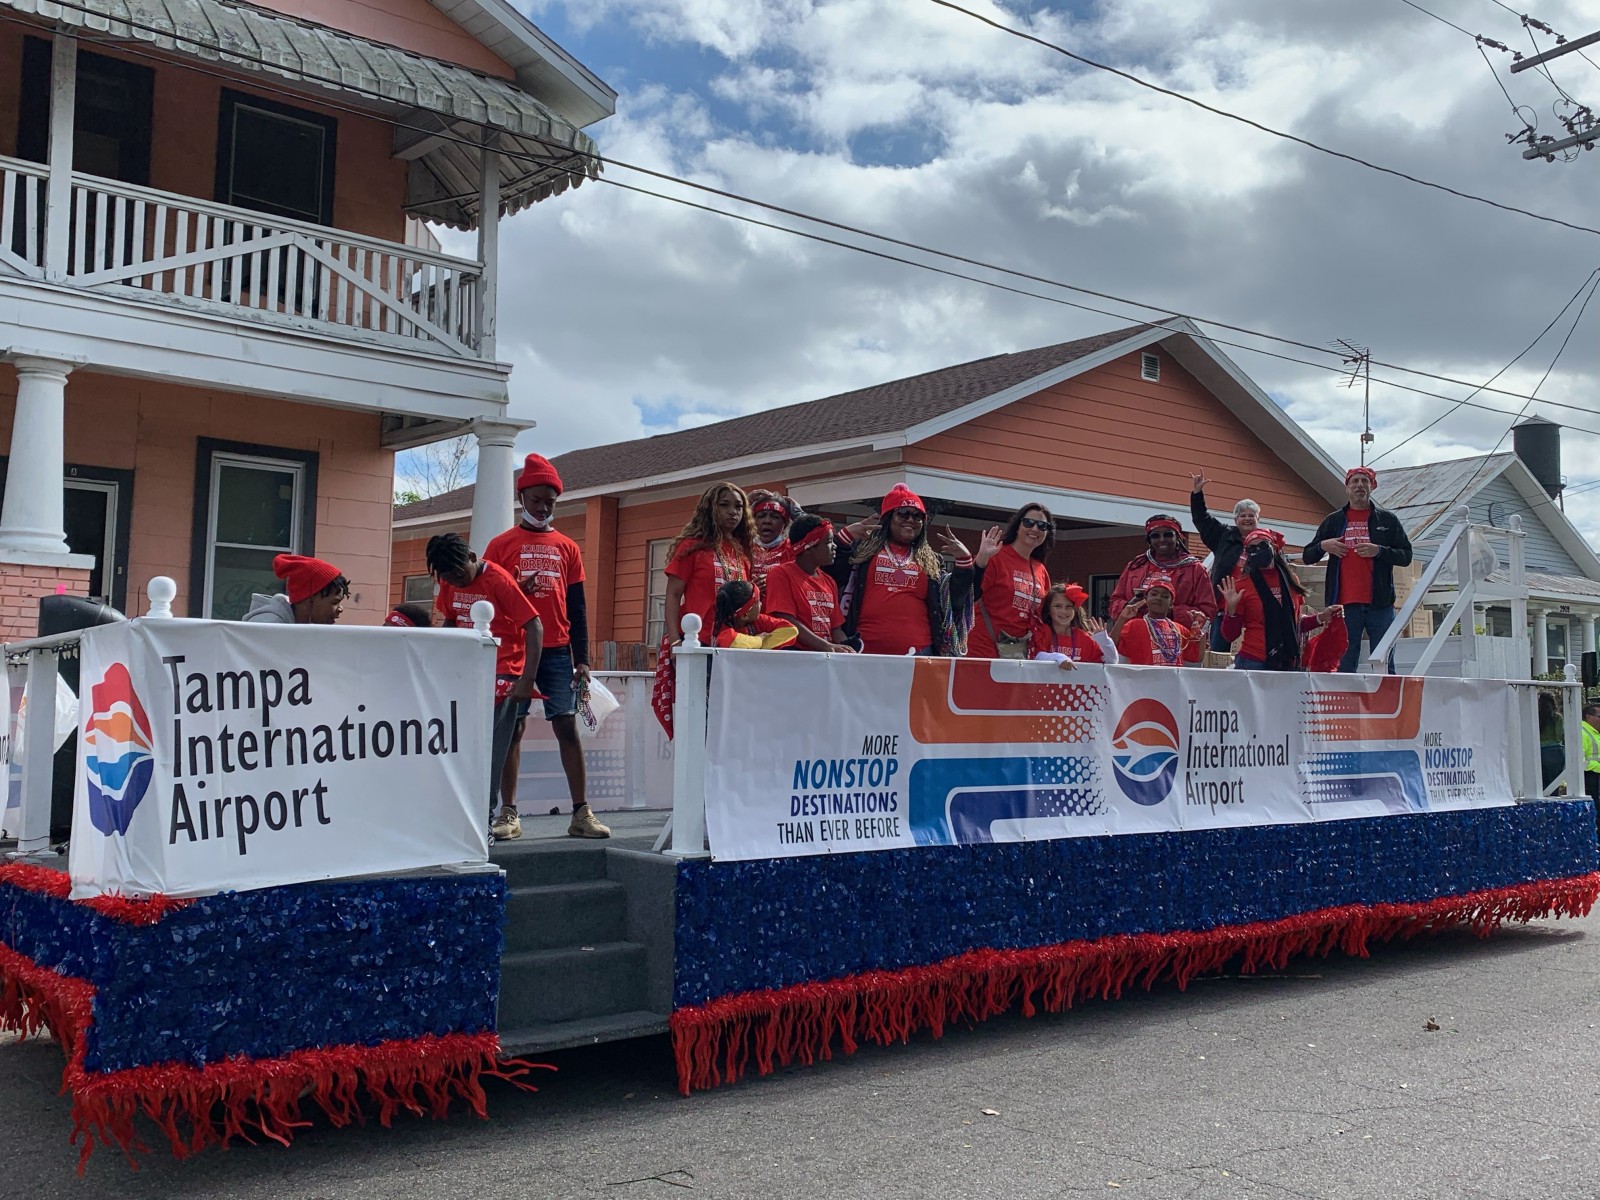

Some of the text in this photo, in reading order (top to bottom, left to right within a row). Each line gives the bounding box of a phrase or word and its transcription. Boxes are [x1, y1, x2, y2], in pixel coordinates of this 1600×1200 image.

[520, 559, 560, 572] DREAM
[162, 655, 313, 727] Tampa
[1188, 699, 1239, 744] Tampa
[173, 700, 459, 777] International
[861, 735, 899, 755] MORE
[1186, 733, 1289, 768] International
[1424, 732, 1442, 747] MORE
[1425, 748, 1473, 769] NONSTOP
[792, 758, 899, 790] NONSTOP
[1426, 770, 1476, 787] DESTINATIONS
[790, 791, 898, 817] DESTINATIONS
[1185, 771, 1245, 816] Airport
[1430, 789, 1446, 804] THAN
[169, 778, 331, 855] Airport
[777, 816, 901, 844] THAN EVER BEFORE
